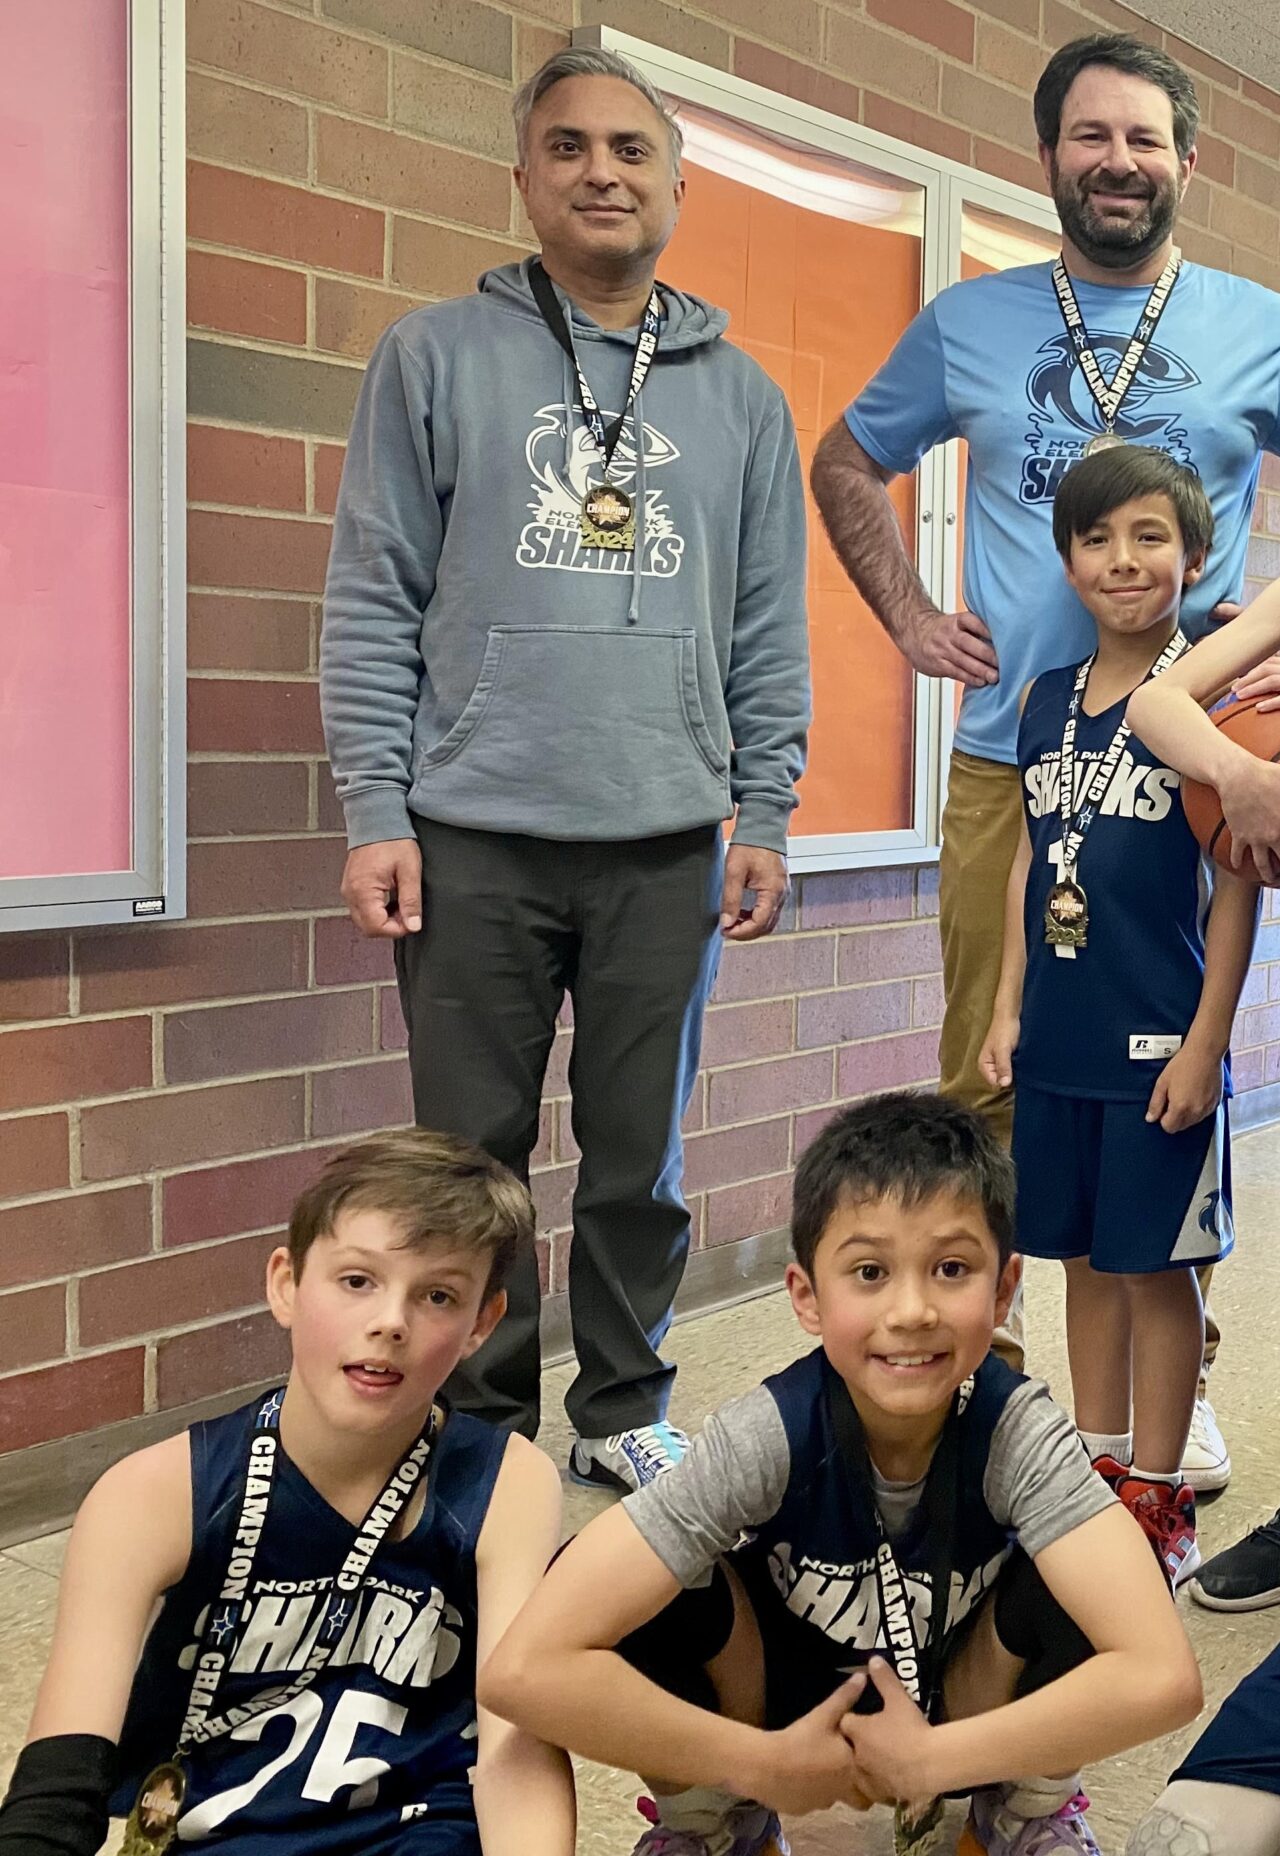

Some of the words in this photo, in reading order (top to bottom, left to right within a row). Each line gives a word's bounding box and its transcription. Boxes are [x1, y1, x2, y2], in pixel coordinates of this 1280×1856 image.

[586, 503, 630, 517] CHAMPION
[581, 531, 635, 549] 2024
[1061, 719, 1077, 820] CHAMPION
[220, 1435, 277, 1601] CHAMPION
[336, 1438, 431, 1592] CHAMPION
[799, 1555, 877, 1577] NORTH
[252, 1576, 335, 1595] NORT
